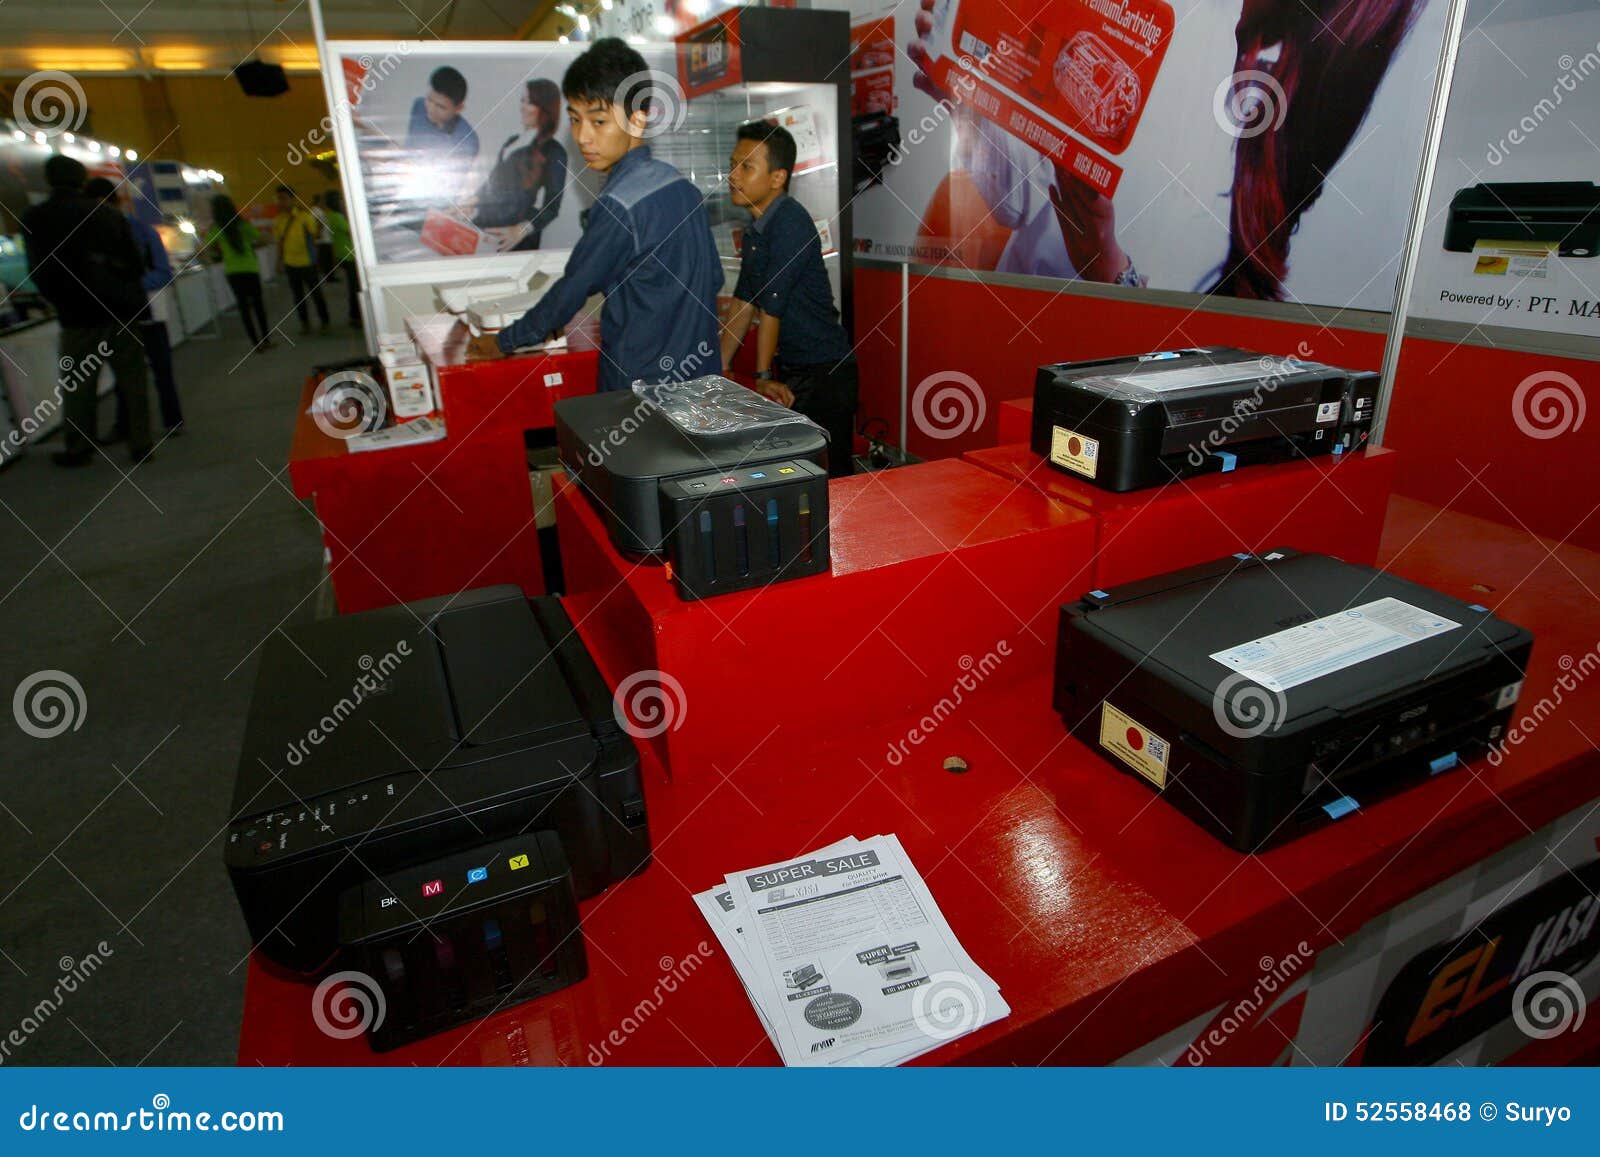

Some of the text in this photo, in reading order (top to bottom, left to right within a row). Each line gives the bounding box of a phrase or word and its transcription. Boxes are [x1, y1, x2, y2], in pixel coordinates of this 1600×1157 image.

[1440, 290, 1495, 306] Powered
[1497, 296, 1514, 310] by
[1528, 296, 1560, 315] PT.
[425, 882, 441, 896] M
[471, 869, 485, 881] C
[513, 857, 524, 867] Y
[754, 854, 873, 888] SUPER SALE
[1405, 934, 1512, 1047] EL
